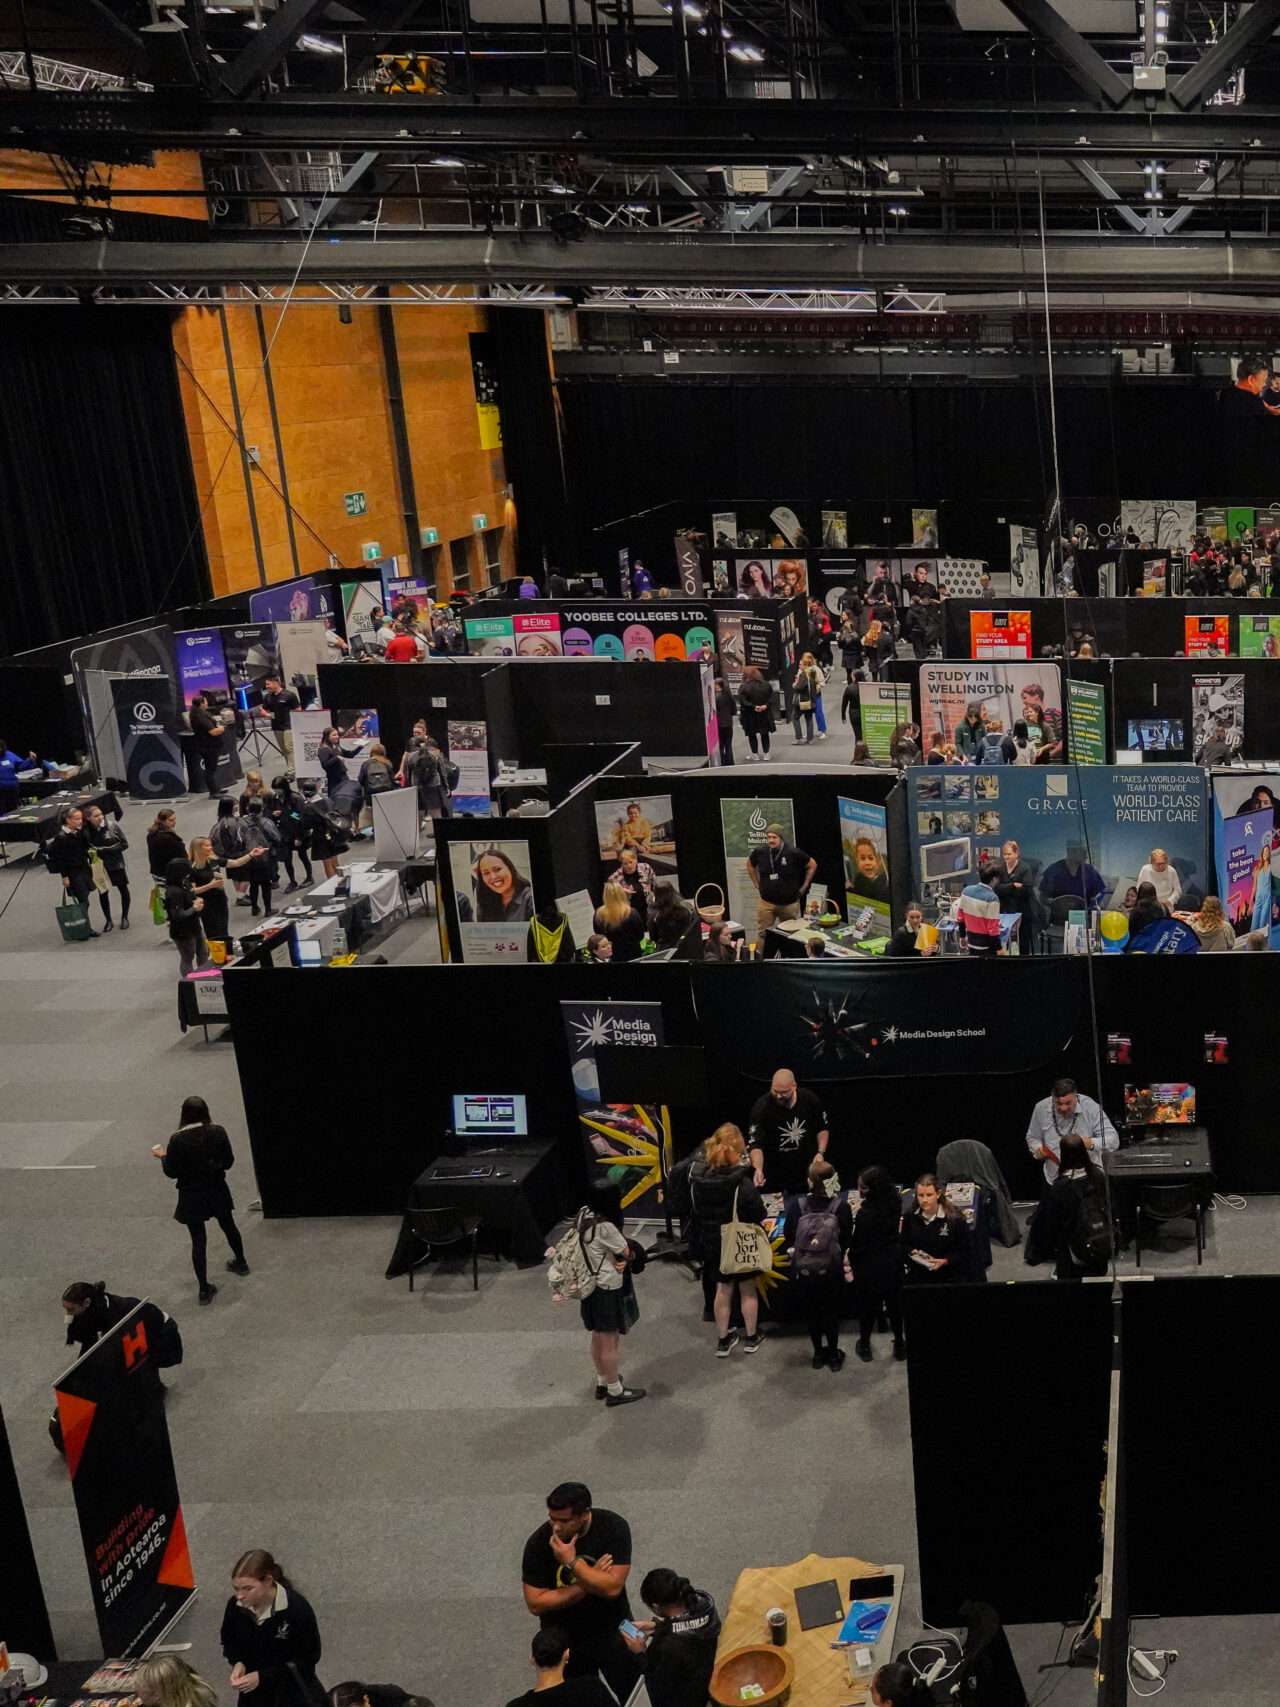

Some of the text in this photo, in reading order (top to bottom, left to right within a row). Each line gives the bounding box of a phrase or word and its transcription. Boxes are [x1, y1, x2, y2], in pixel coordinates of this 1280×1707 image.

[530, 618, 551, 627] Elite
[564, 611, 708, 622] YOOBEE COLLEGES LTD.
[483, 623, 505, 631] Elite
[928, 671, 989, 681] STUDY IN
[928, 684, 1014, 694] WELLINGTON
[1121, 776, 1142, 784] TAKES
[1149, 776, 1200, 784] WORLD-CLASS
[1127, 784, 1186, 792] TEAM TO PROVIDE
[1027, 798, 1088, 811] GRACE
[1112, 795, 1200, 808] WORLD-CLASS
[1116, 809, 1198, 822] PATIENT CARE
[1232, 848, 1245, 858] take
[1229, 857, 1253, 870] the beat
[1232, 867, 1251, 882] global
[612, 1019, 651, 1030] Media
[614, 1030, 656, 1044] Design
[899, 1028, 986, 1039] Media Design School
[735, 1253, 760, 1267] City.
[122, 1322, 148, 1368] H
[96, 1503, 144, 1561] Building
[99, 1507, 155, 1576] with pride
[101, 1513, 166, 1593] in Aotearoa
[104, 1532, 166, 1608] since 1946.
